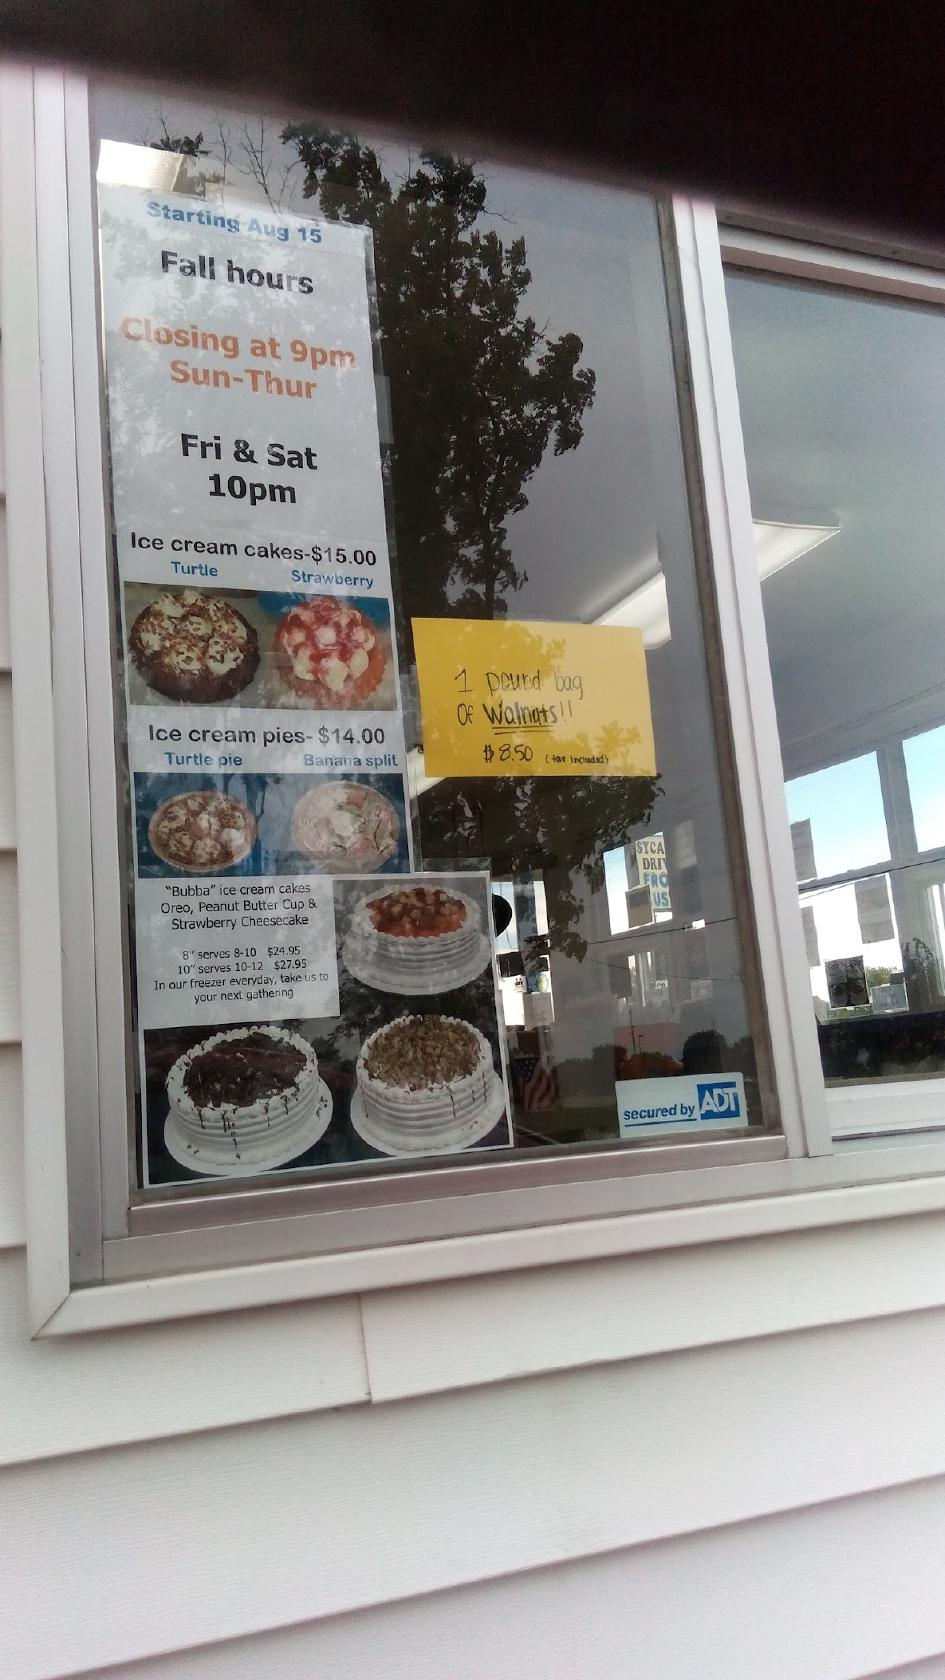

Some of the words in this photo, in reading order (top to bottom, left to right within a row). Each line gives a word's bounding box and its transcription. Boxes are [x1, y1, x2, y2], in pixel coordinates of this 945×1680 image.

[147, 201, 240, 233] Starting
[248, 218, 289, 241] Aug
[298, 227, 322, 243] 15
[161, 250, 216, 281] Fall
[227, 259, 314, 294] hours
[120, 316, 239, 359] Closing
[250, 336, 281, 360] at
[290, 340, 355, 369] 9pm
[170, 360, 317, 399] Sun-Thur
[181, 433, 221, 460] Fri
[233, 439, 258, 464] &
[267, 443, 318, 470] Sat
[208, 473, 297, 506] 10pm
[131, 531, 164, 550] Ice
[171, 538, 238, 556] cream
[244, 542, 377, 566] cakes-$15.00
[171, 561, 218, 577] Turtle
[291, 570, 374, 589] Strawberry
[454, 669, 473, 693] 1
[485, 669, 541, 696] pound
[554, 668, 584, 700] bag
[149, 724, 182, 742] Ice
[188, 729, 256, 744] cream
[318, 725, 385, 747] $14.00
[164, 752, 212, 766] Turtle
[218, 753, 243, 768] pie
[304, 754, 361, 767] Banana
[365, 753, 399, 769] split
[219, 884, 236, 895] ice
[240, 884, 275, 895] cream
[279, 883, 311, 894] cakes
[160, 902, 194, 915] Oreo,
[199, 901, 240, 912] Peanut
[243, 900, 279, 911] Butter
[282, 899, 305, 912] Cup
[308, 899, 317, 909] &
[171, 918, 237, 931] Strawberry
[241, 915, 309, 927] Cheesecake
[197, 950, 230, 959] serves
[233, 947, 257, 958] 8-10
[267, 946, 301, 957] $24.95
[198, 964, 231, 974] serves
[235, 961, 264, 972] 10-12
[273, 959, 307, 971] $27.95
[154, 980, 165, 991] In
[168, 980, 187, 990] our
[189, 977, 226, 989] freezer
[229, 975, 277, 988] everyday,
[280, 974, 302, 984] take
[304, 973, 316, 982] us
[319, 972, 329, 981] to
[193, 993, 217, 1005] your
[220, 990, 243, 1001] next
[246, 988, 294, 1001] gathering
[623, 1104, 677, 1120] secured
[680, 1103, 695, 1117] by
[700, 1086, 738, 1114] ADT
